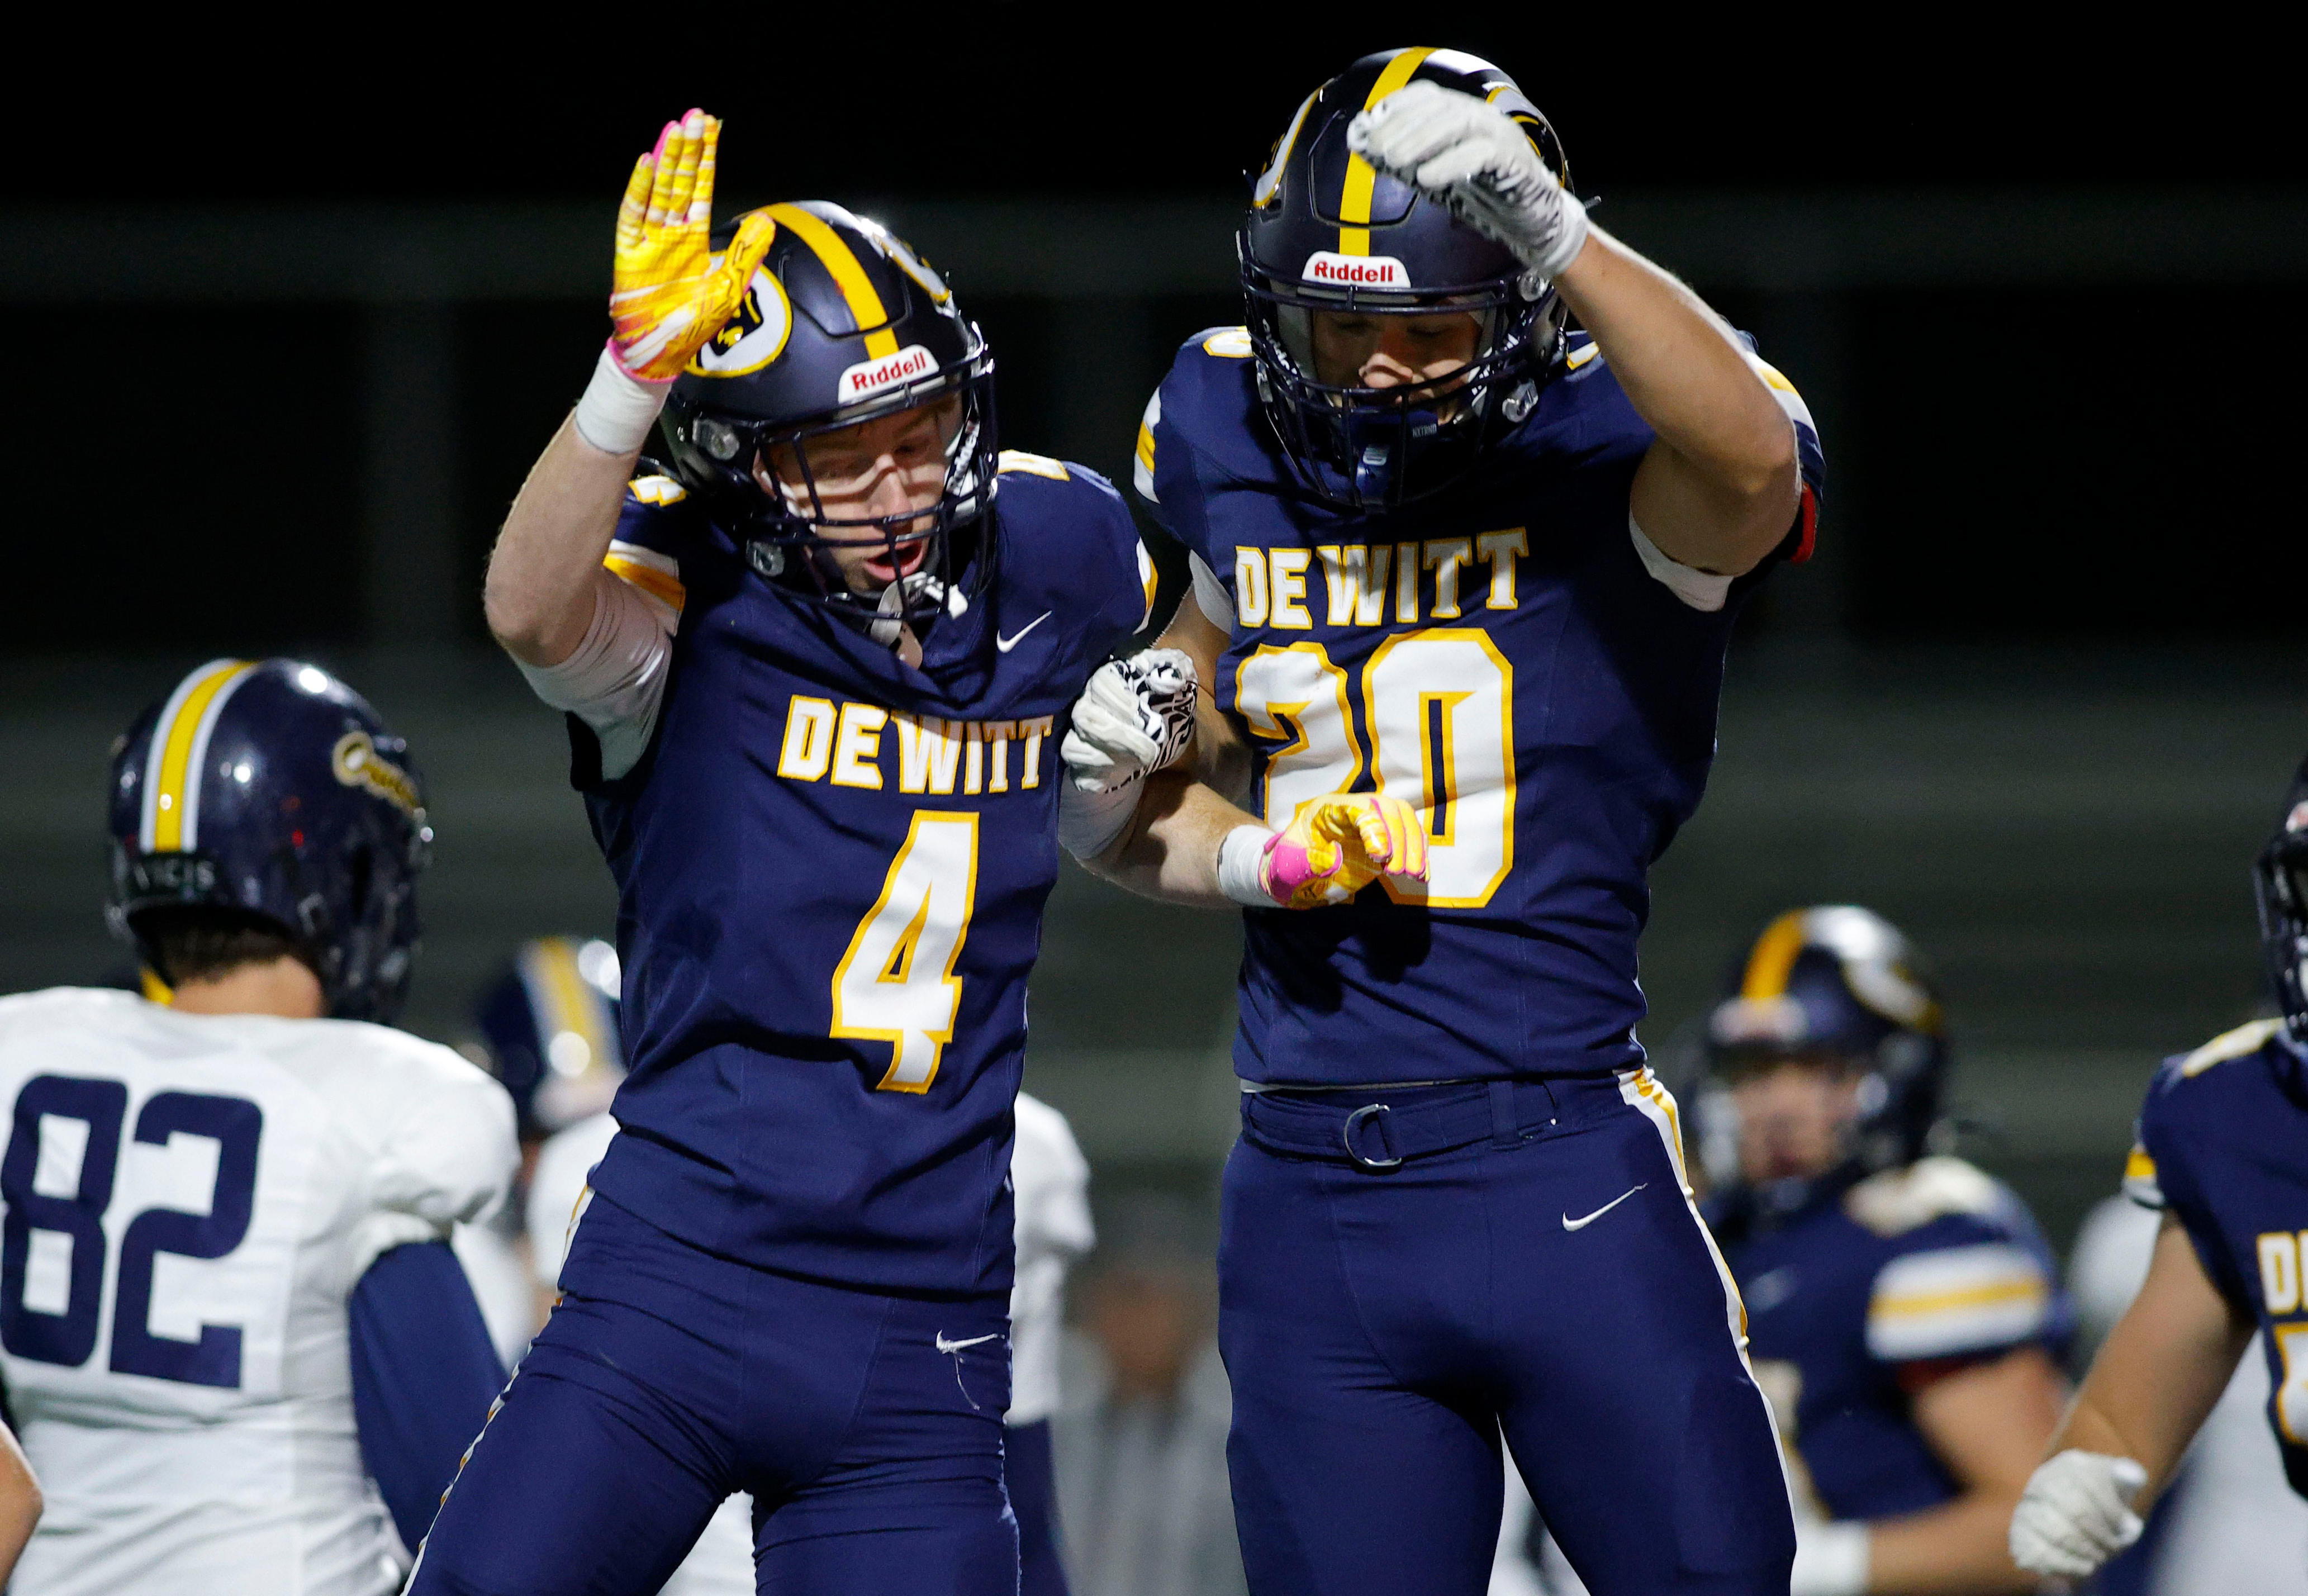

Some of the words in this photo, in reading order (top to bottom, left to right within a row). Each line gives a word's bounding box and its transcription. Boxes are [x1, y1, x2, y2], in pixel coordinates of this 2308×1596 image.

[852, 352, 927, 391] Riddell
[1315, 260, 1393, 282] Riddell
[1234, 628, 1517, 908] 20
[829, 809, 980, 1094] 4
[0, 1073, 264, 1390] 82
